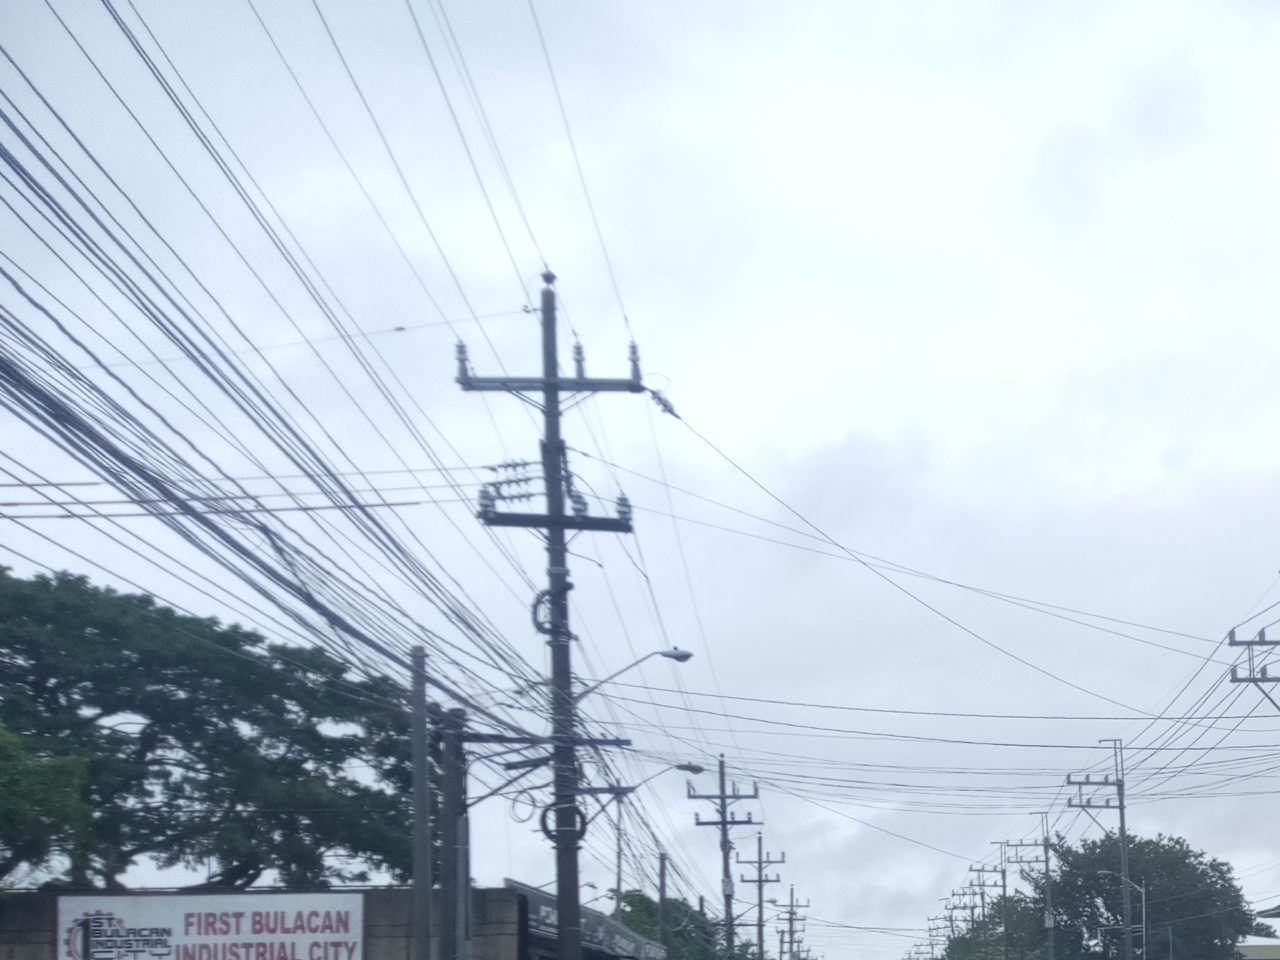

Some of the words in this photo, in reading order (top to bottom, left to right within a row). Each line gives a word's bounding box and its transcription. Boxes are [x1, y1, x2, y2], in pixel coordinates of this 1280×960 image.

[184, 911, 246, 936] FIRST
[251, 910, 351, 935] BULACAN
[91, 928, 172, 938] BULACAN
[90, 938, 172, 949] INDUSTRIAL
[91, 949, 172, 960] CITY
